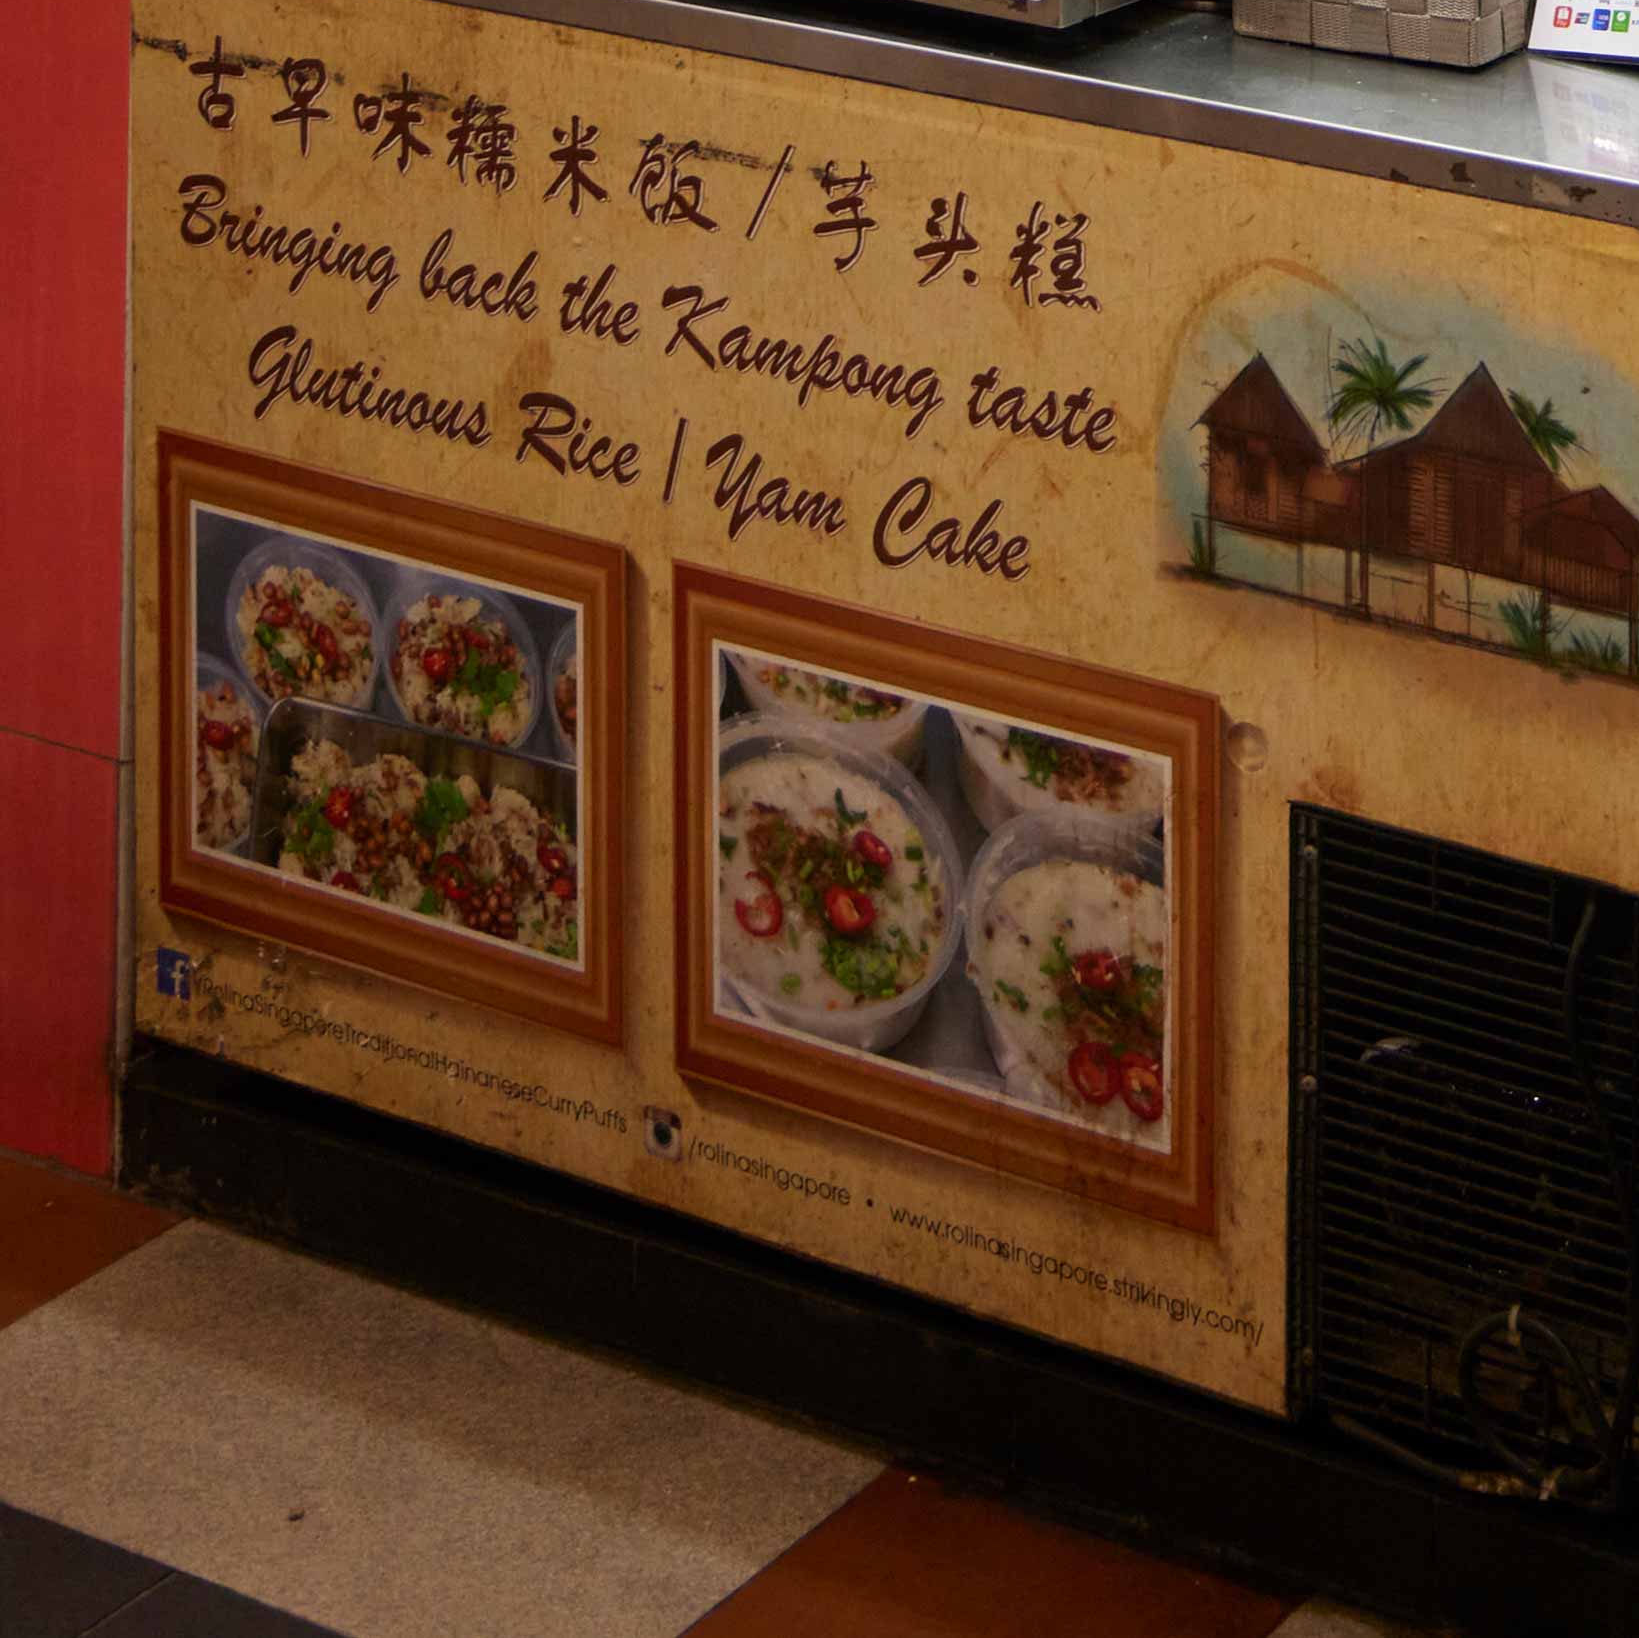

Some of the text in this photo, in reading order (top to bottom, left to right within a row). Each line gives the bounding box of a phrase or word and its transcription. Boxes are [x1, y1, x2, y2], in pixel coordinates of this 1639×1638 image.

[179, 173, 1117, 454] Bringing back the Kampong taste
[247, 326, 491, 444] Glutinous
[516, 393, 640, 487] Rice
[705, 434, 846, 539] Yam
[872, 476, 1032, 581] Cake
[690, 1136, 852, 1207] /rolinasingapore
